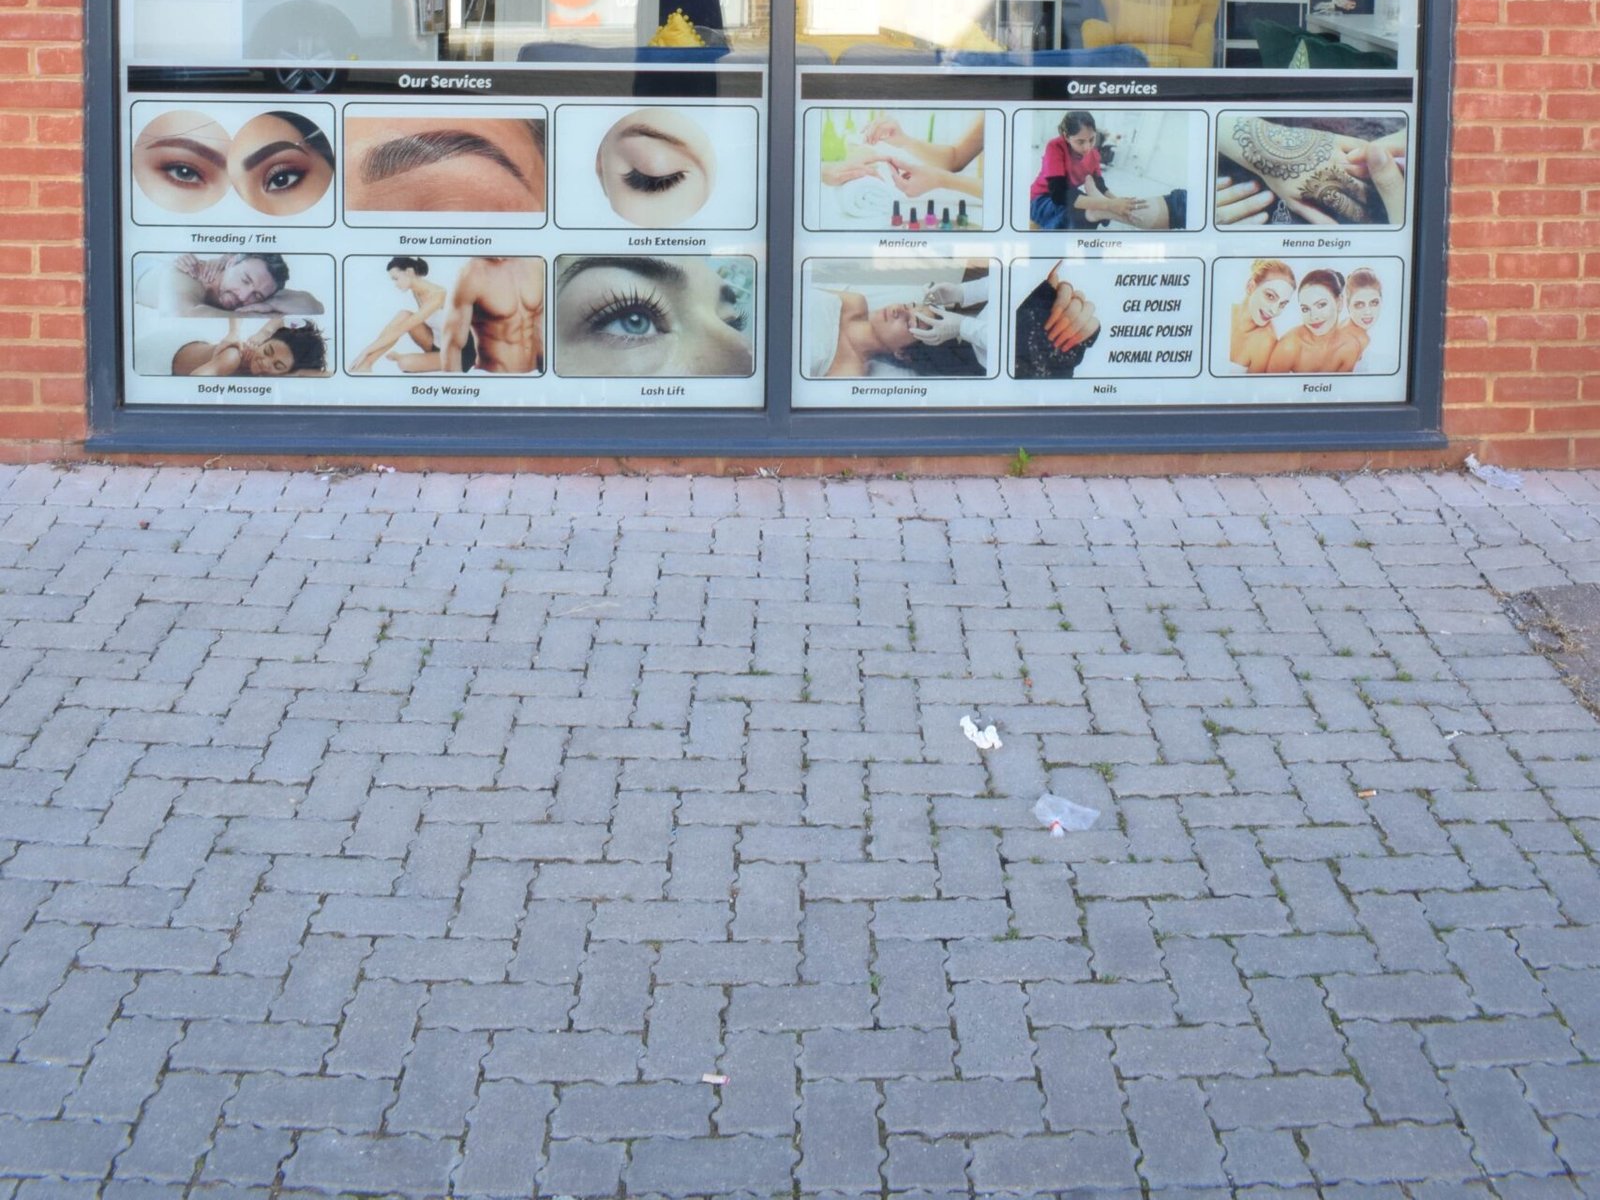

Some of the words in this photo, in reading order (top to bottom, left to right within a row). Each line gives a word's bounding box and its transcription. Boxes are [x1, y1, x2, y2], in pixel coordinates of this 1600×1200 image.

[398, 74, 429, 88] Our
[431, 74, 492, 89] Services
[1067, 80, 1097, 94] Our
[1098, 80, 1158, 95] Services
[191, 233, 246, 246] Threading
[255, 233, 277, 244] Tint
[399, 235, 427, 245] Brow
[430, 235, 492, 246] Lamination
[628, 236, 652, 246] Lash
[654, 236, 706, 246] Extension
[879, 238, 928, 248] Manicure
[1077, 238, 1123, 249] Pedicure
[1282, 238, 1315, 248] Henna
[1317, 238, 1351, 250] Design
[1114, 274, 1158, 287] ACRYLIC
[1159, 274, 1191, 287] NAILS
[1122, 299, 1141, 313] GEL
[1143, 299, 1182, 312] POLISH
[1109, 324, 1154, 338] SHELLAC
[1155, 324, 1193, 337] POLISH
[1108, 350, 1153, 363] NORMAL
[1155, 350, 1193, 363] POLISH
[198, 384, 226, 395] Body
[227, 384, 272, 395] Massage
[411, 386, 439, 397] Body
[441, 386, 480, 398] Waxing
[641, 386, 664, 396] Lash
[666, 386, 685, 396] Lift
[851, 386, 928, 398] Dermaplaning
[1093, 384, 1117, 394] Nails
[1302, 383, 1332, 393] Facial
